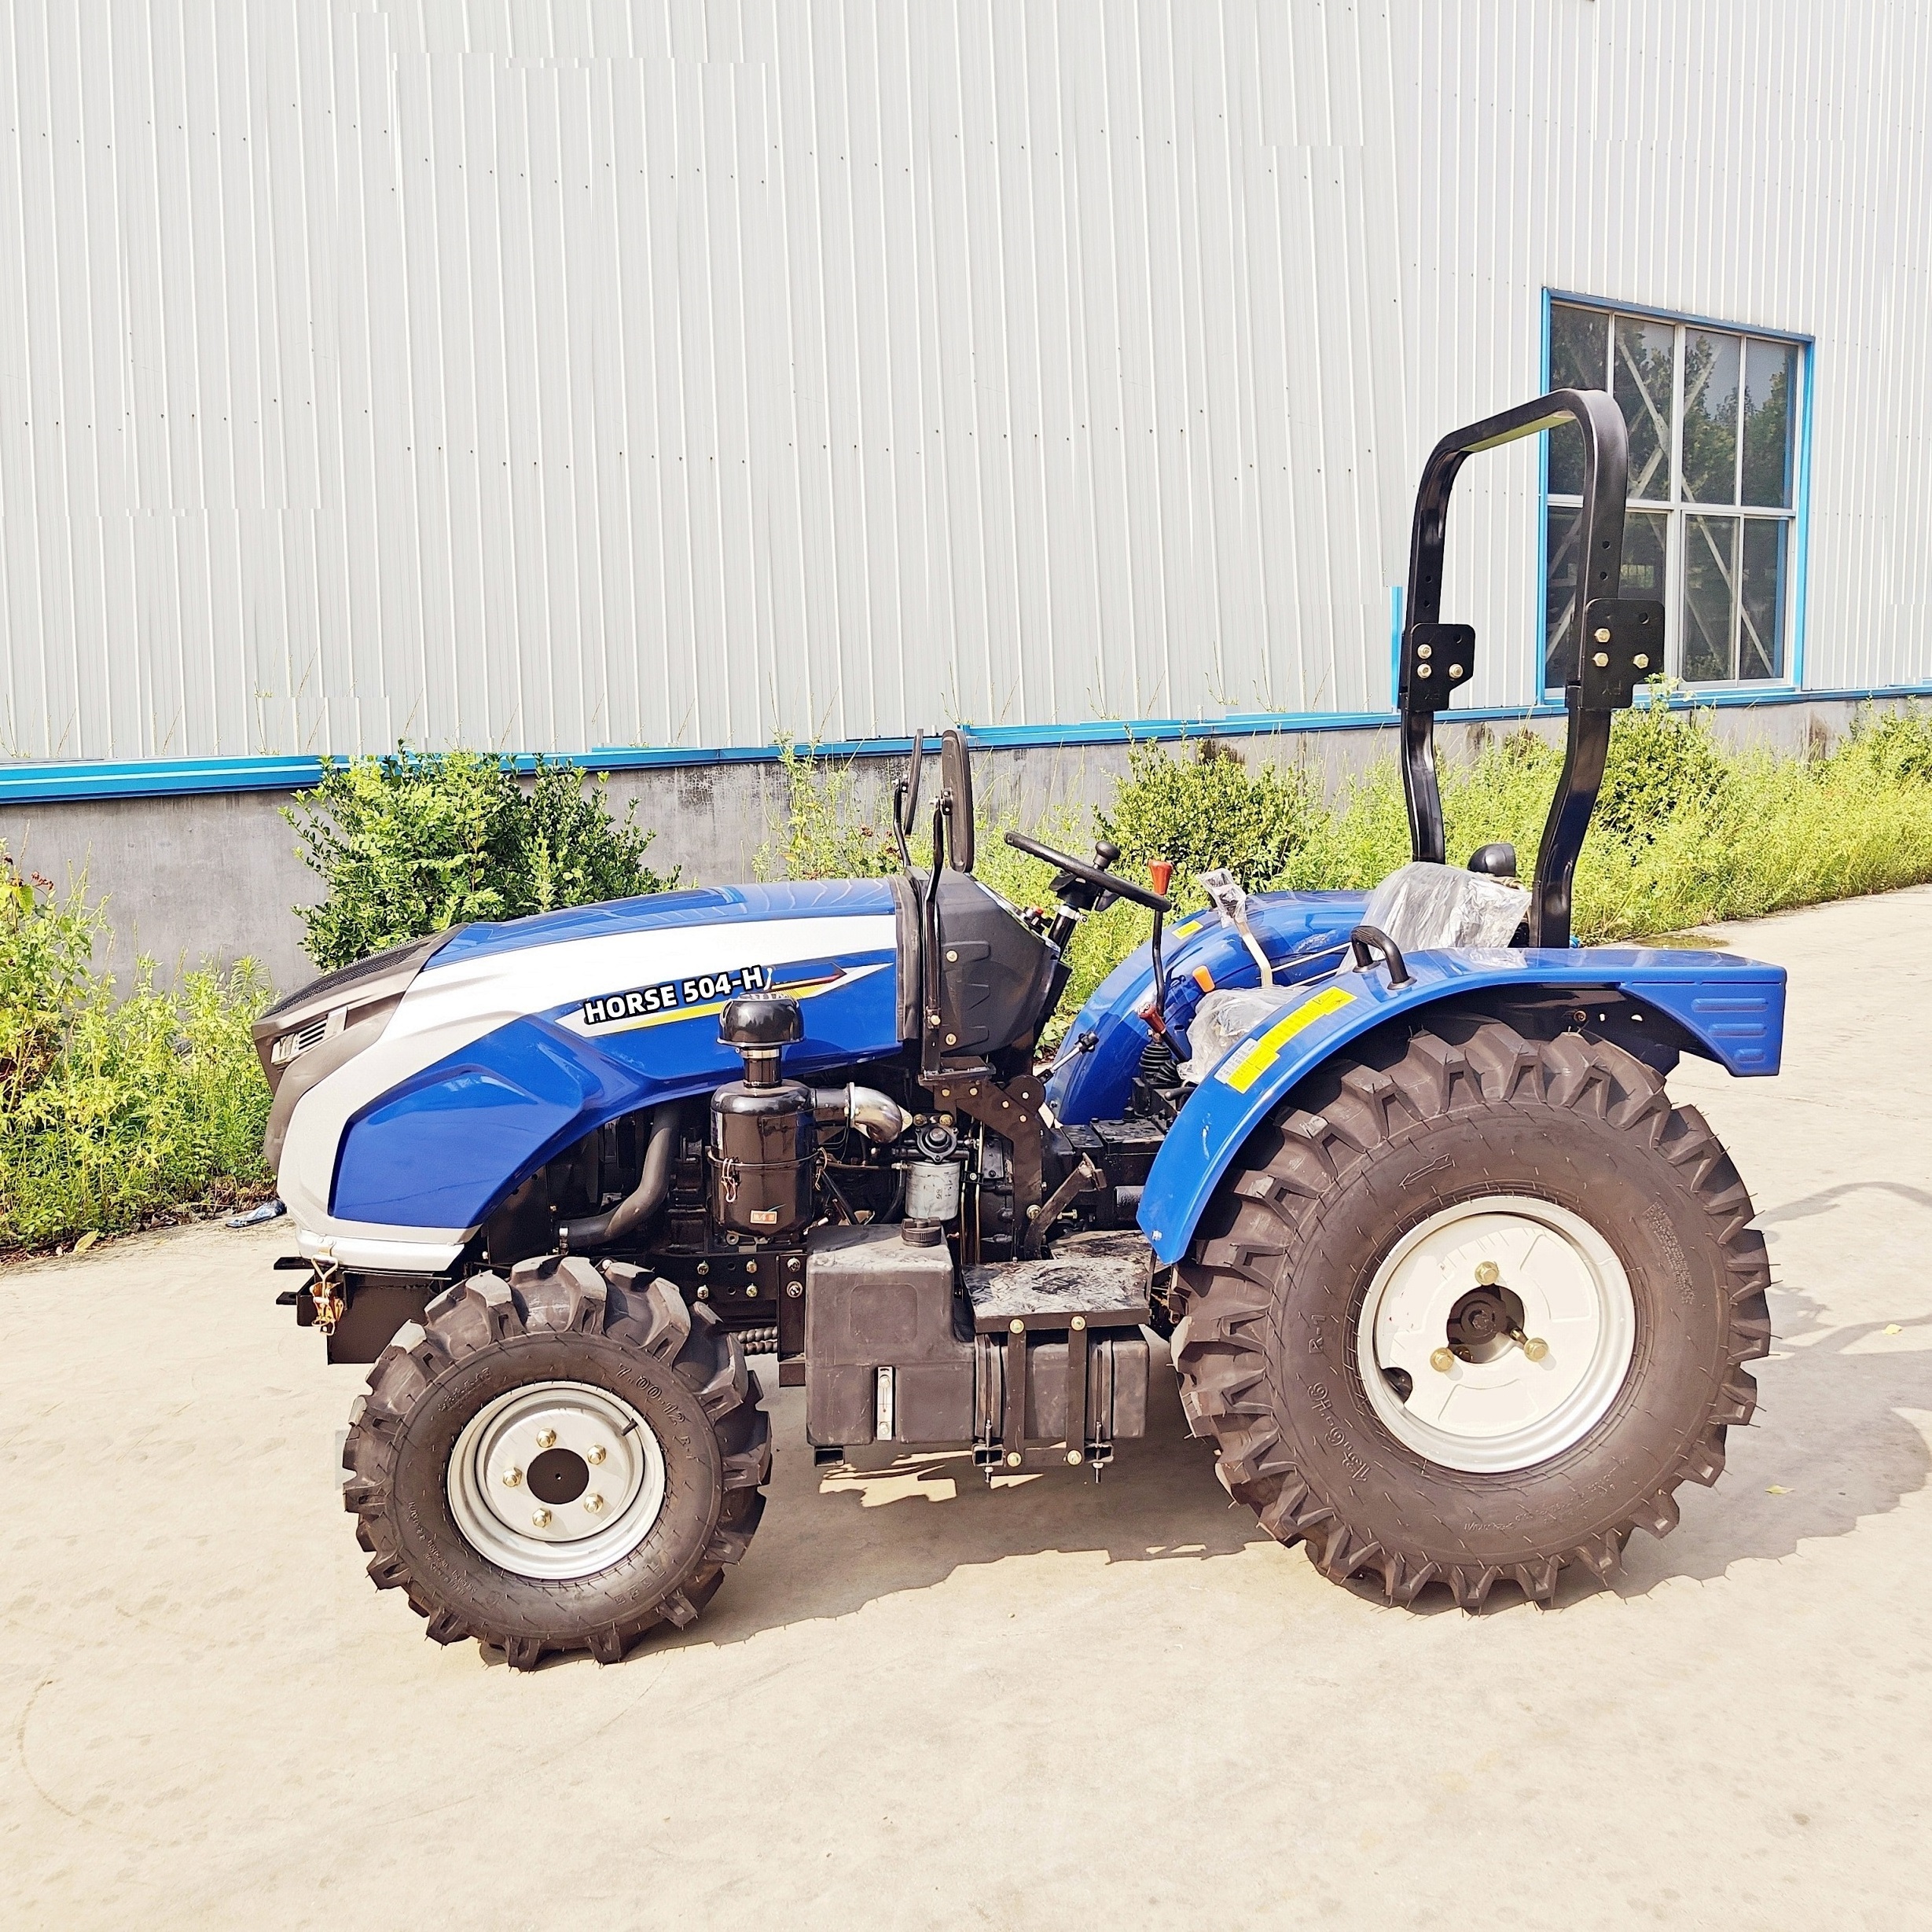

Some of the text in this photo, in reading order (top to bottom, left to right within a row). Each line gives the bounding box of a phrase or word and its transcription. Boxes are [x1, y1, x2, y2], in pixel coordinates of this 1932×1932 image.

[584, 965, 764, 1024] HORSE 504-H
[1308, 1313, 1327, 1354] R-1
[615, 1362, 686, 1427] 7.00-12
